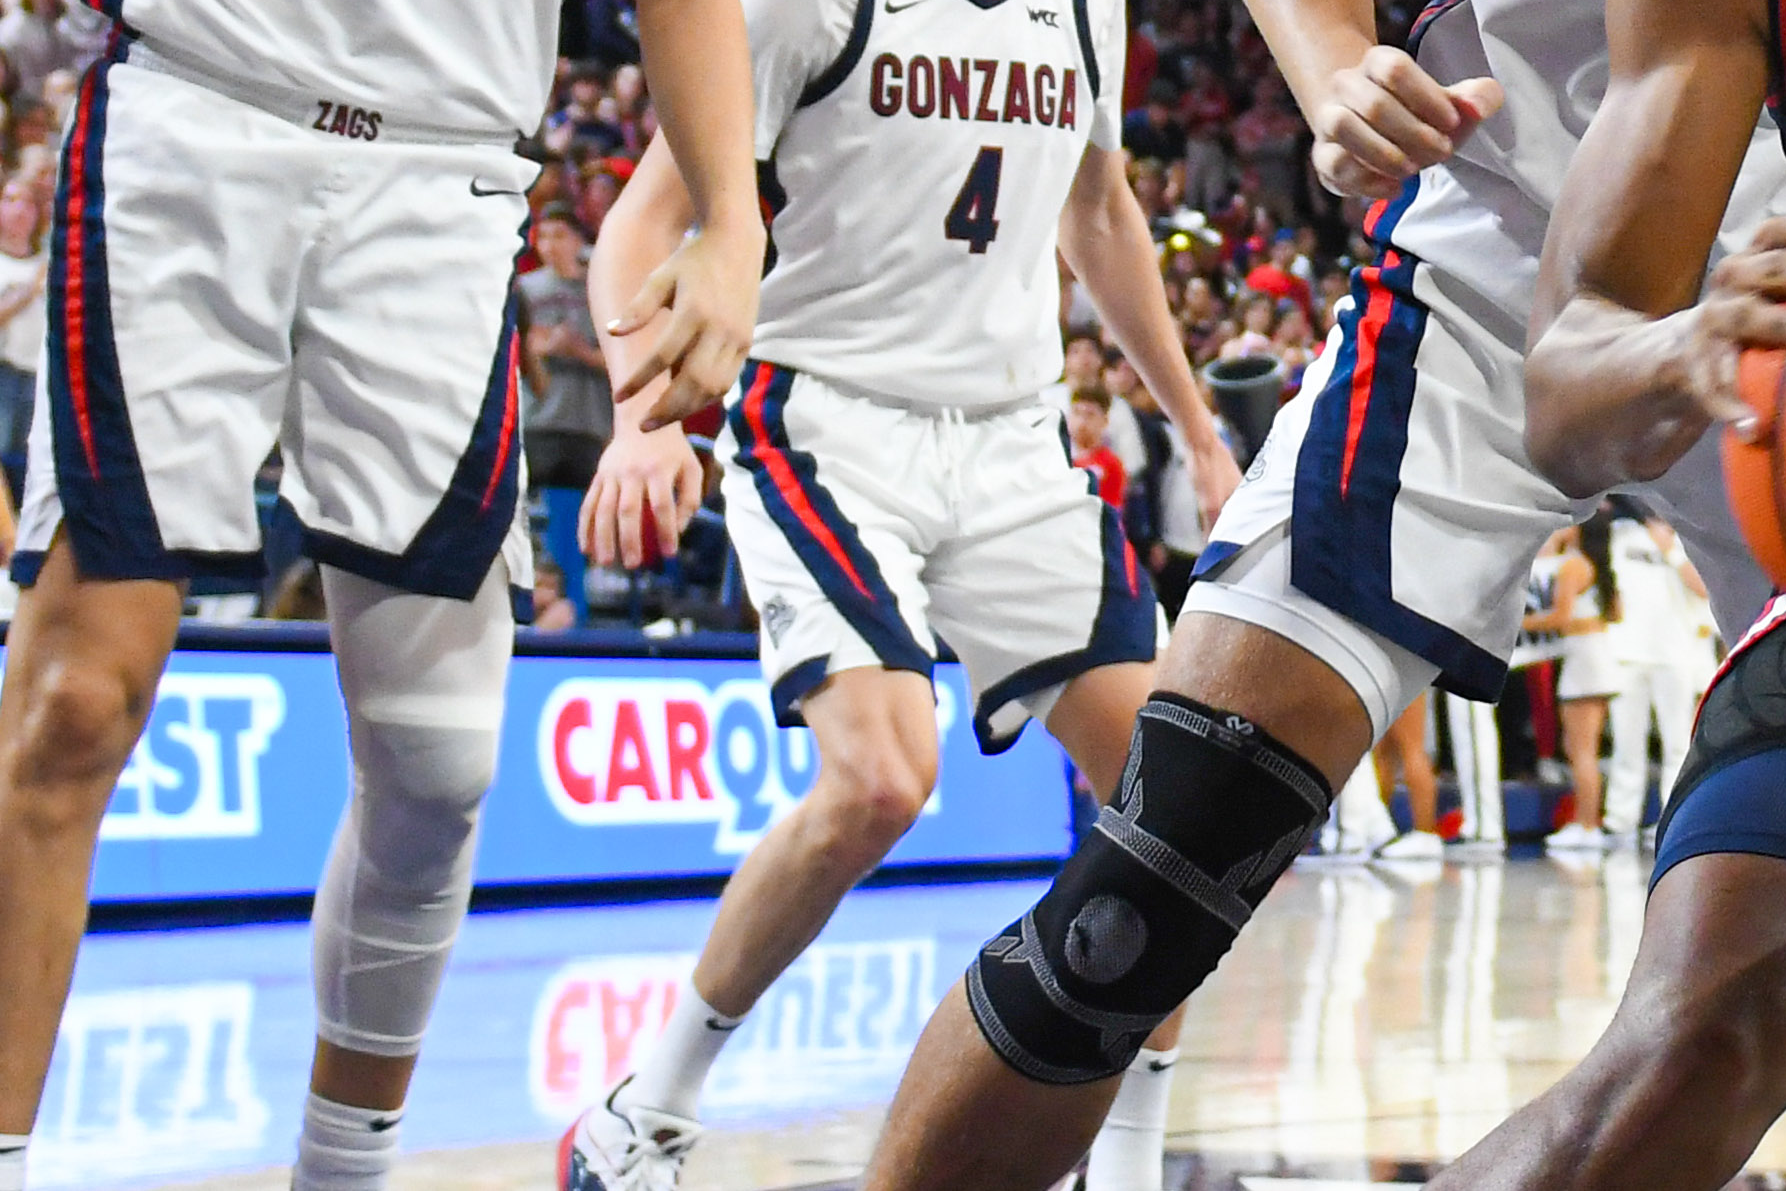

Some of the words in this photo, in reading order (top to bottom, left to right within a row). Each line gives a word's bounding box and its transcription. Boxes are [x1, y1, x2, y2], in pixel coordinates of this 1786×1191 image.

[312, 100, 382, 142] ZAGS
[869, 52, 1077, 131] GONZAGA
[944, 145, 1003, 254] 4
